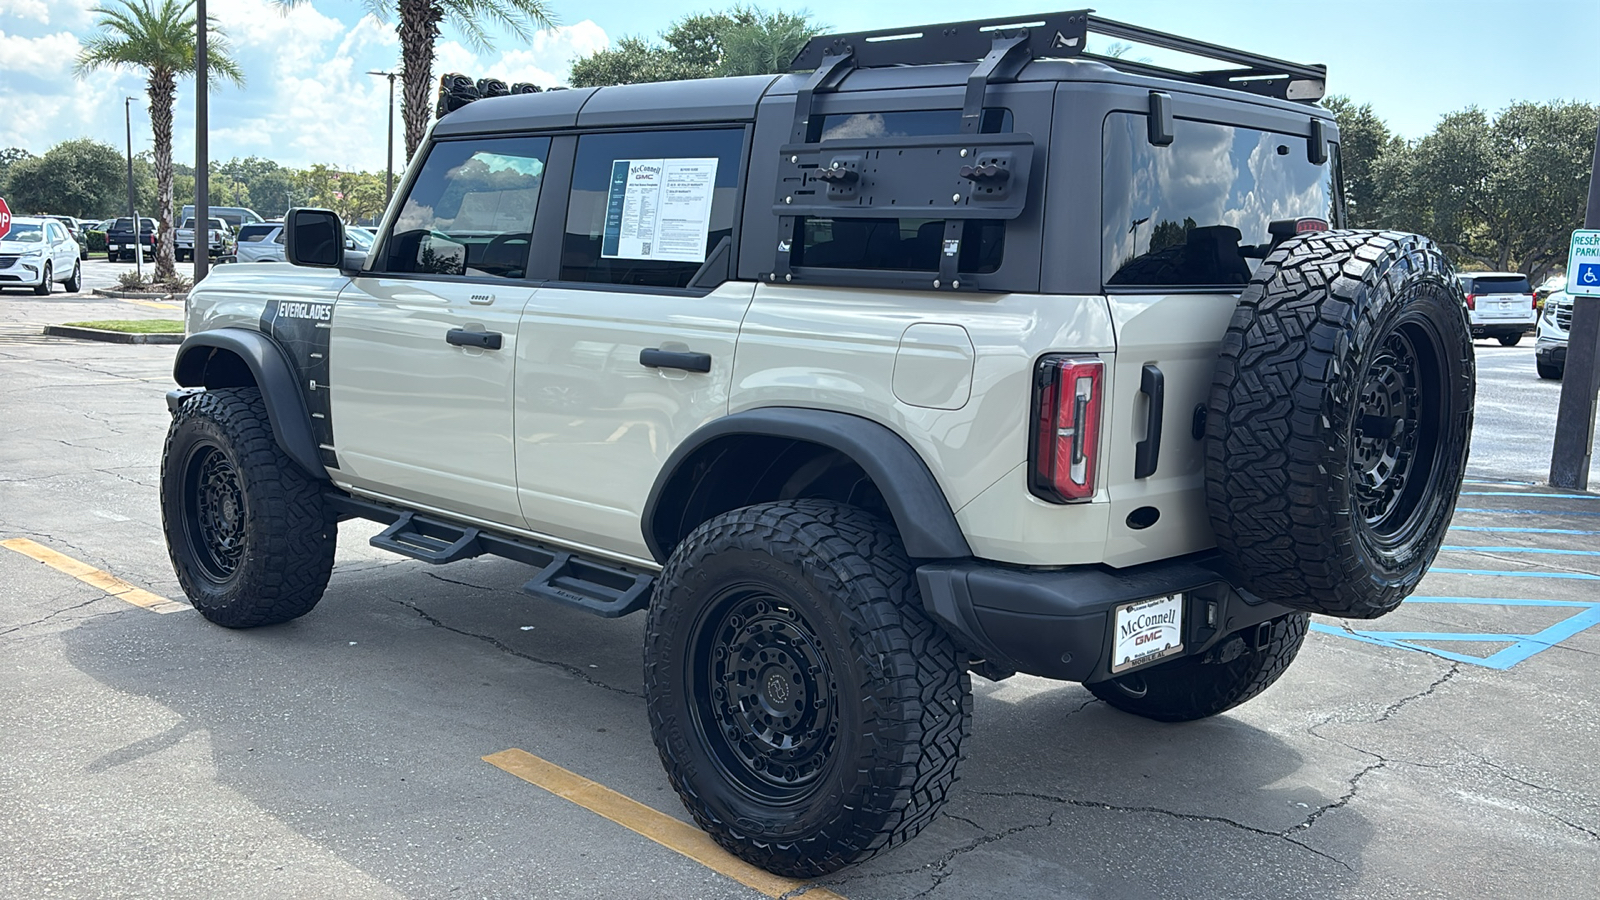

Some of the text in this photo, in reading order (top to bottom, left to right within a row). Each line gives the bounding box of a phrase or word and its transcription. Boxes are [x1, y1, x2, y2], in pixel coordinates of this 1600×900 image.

[630, 164, 661, 175] McConnell
[0, 212, 9, 228] P
[1575, 247, 1600, 257] PARKI
[279, 302, 331, 320] EVERGLADES
[1121, 608, 1176, 640] McConnell
[1135, 629, 1163, 646] GMC
